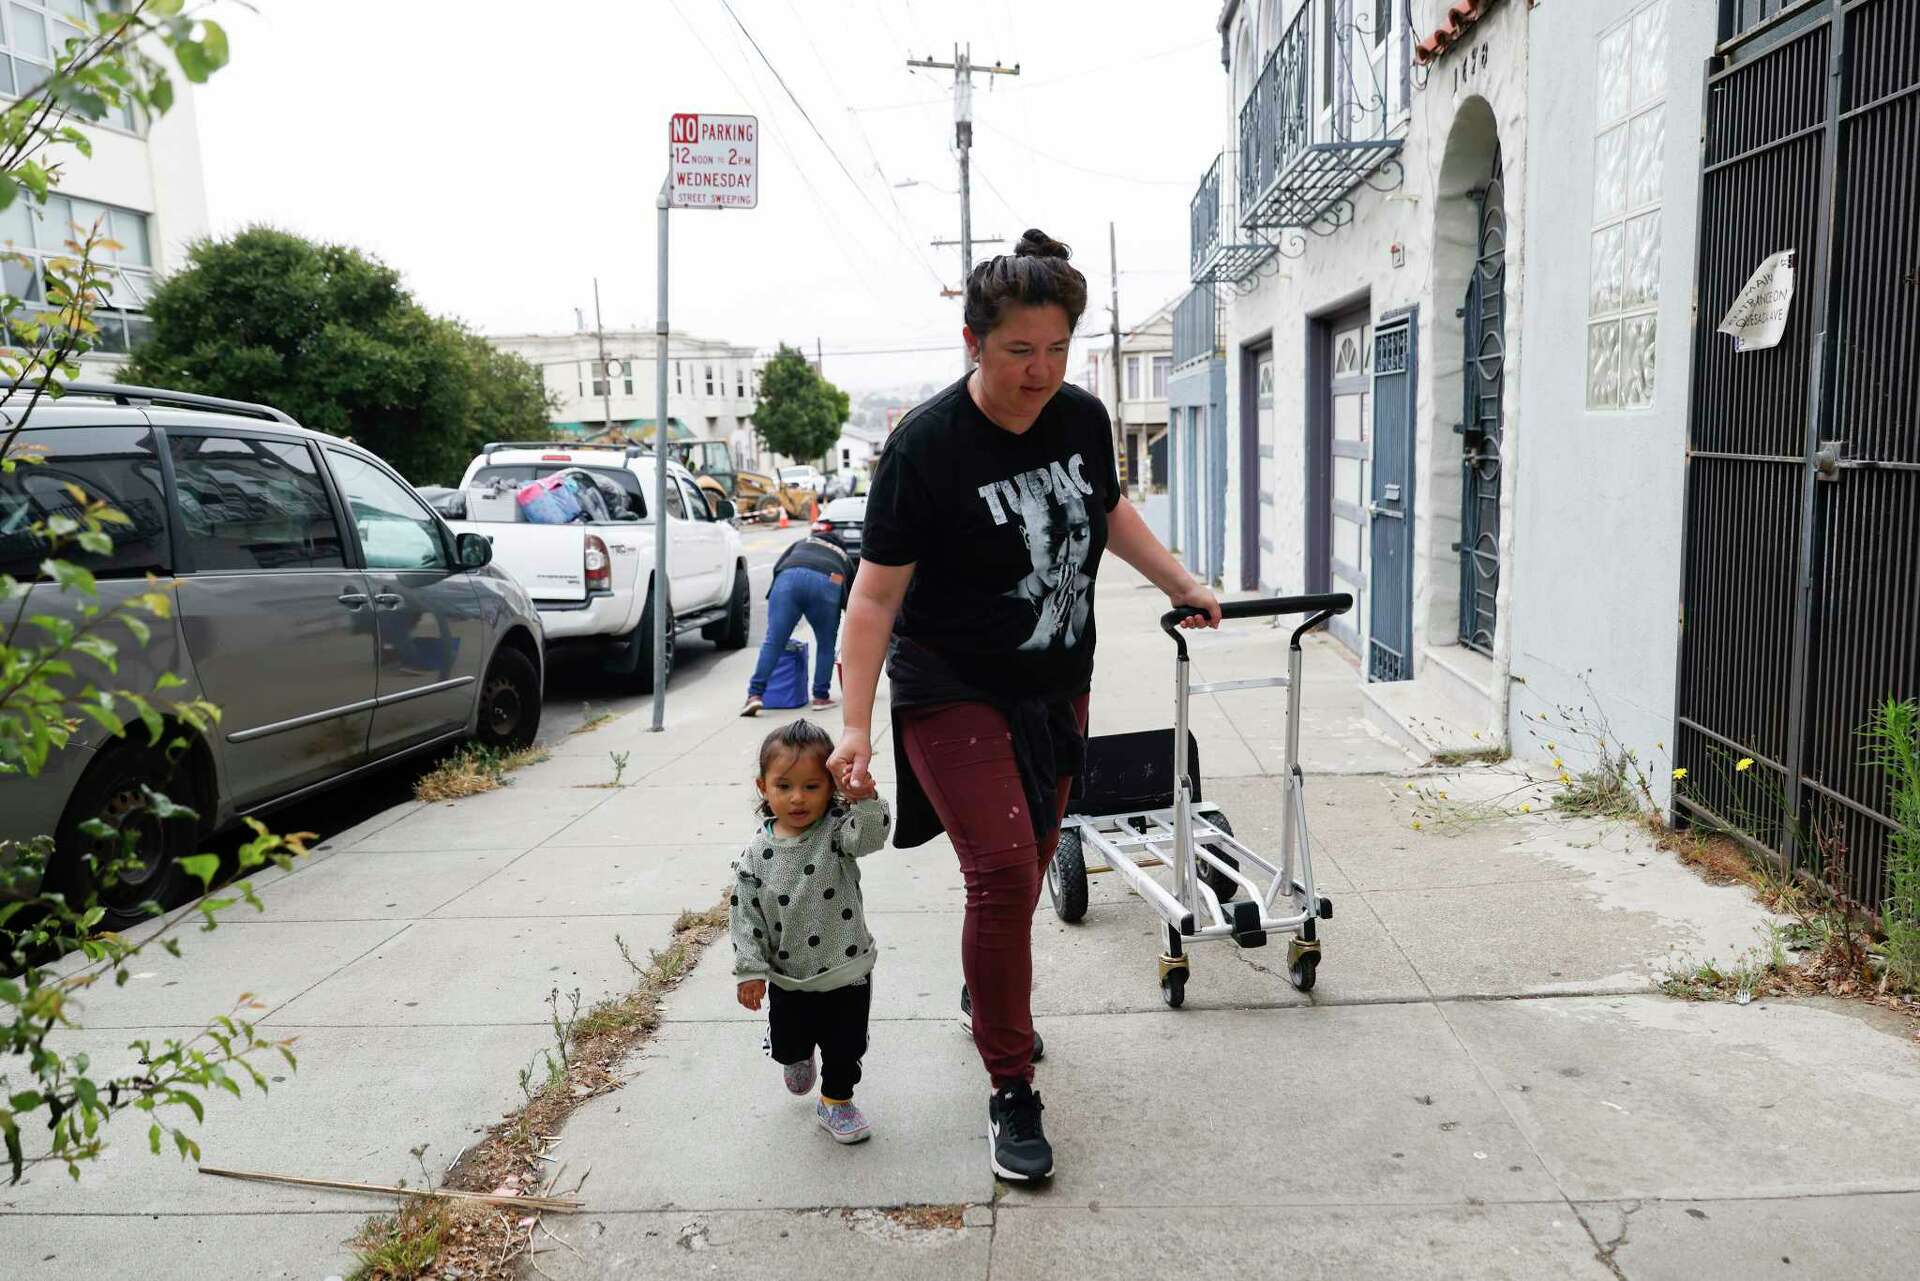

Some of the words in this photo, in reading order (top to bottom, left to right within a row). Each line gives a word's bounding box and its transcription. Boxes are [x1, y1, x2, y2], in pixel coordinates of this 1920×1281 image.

[673, 117, 697, 142] NO
[702, 123, 753, 142] PARKING
[677, 172, 752, 187] WEDNESDAY
[678, 192, 706, 204] STREET
[711, 194, 751, 205] SWEEPING
[978, 453, 1093, 526] TUPAC
